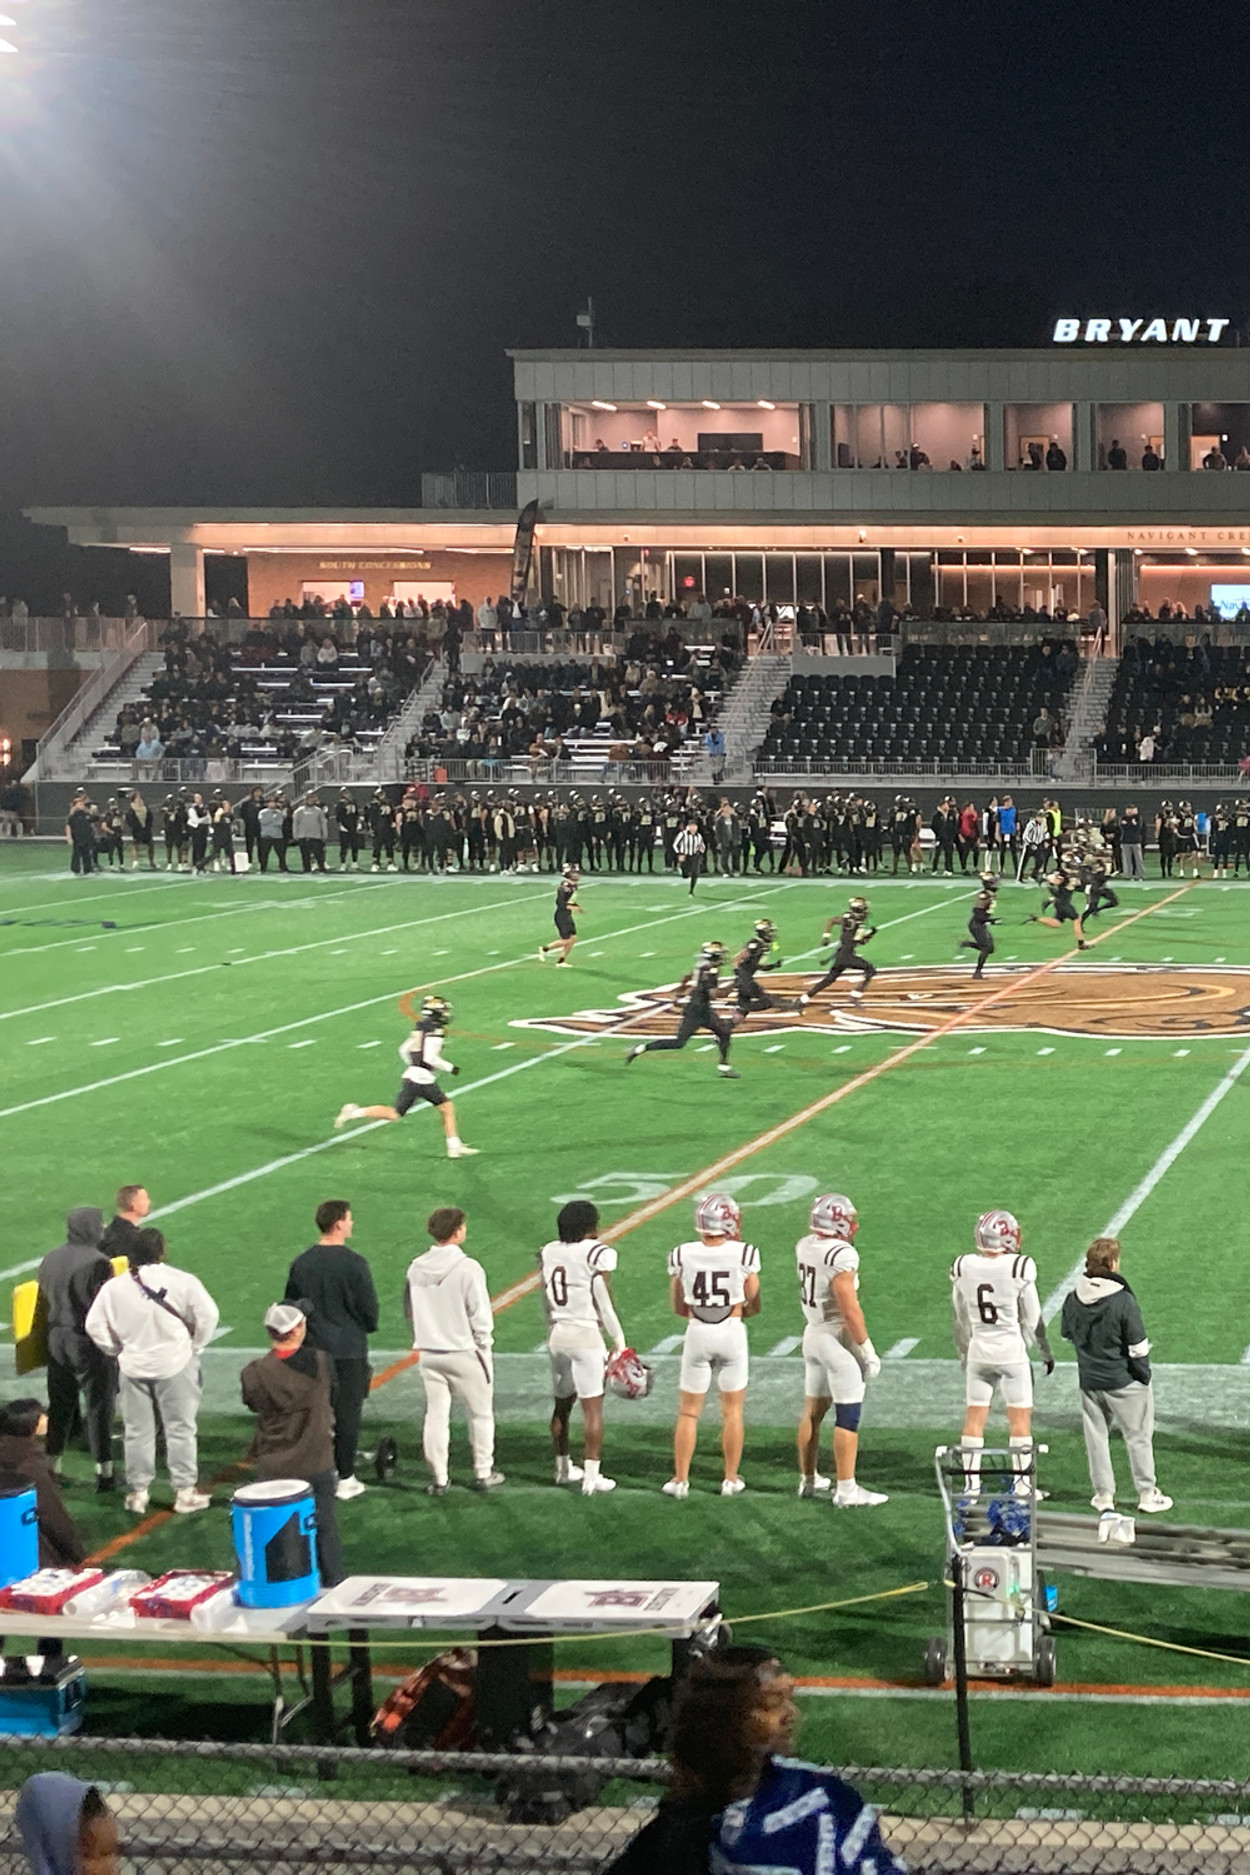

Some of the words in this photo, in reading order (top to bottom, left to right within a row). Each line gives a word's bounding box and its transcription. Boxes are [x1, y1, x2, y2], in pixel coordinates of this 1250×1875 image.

[1053, 318, 1229, 342] BRYANT
[1127, 531, 1207, 541] NAVIGANT
[319, 561, 355, 569] SOUTH
[358, 561, 431, 569] CONCESSIONS
[551, 1266, 568, 1307] 0
[693, 1271, 730, 1307] 45
[977, 1284, 998, 1324] 6
